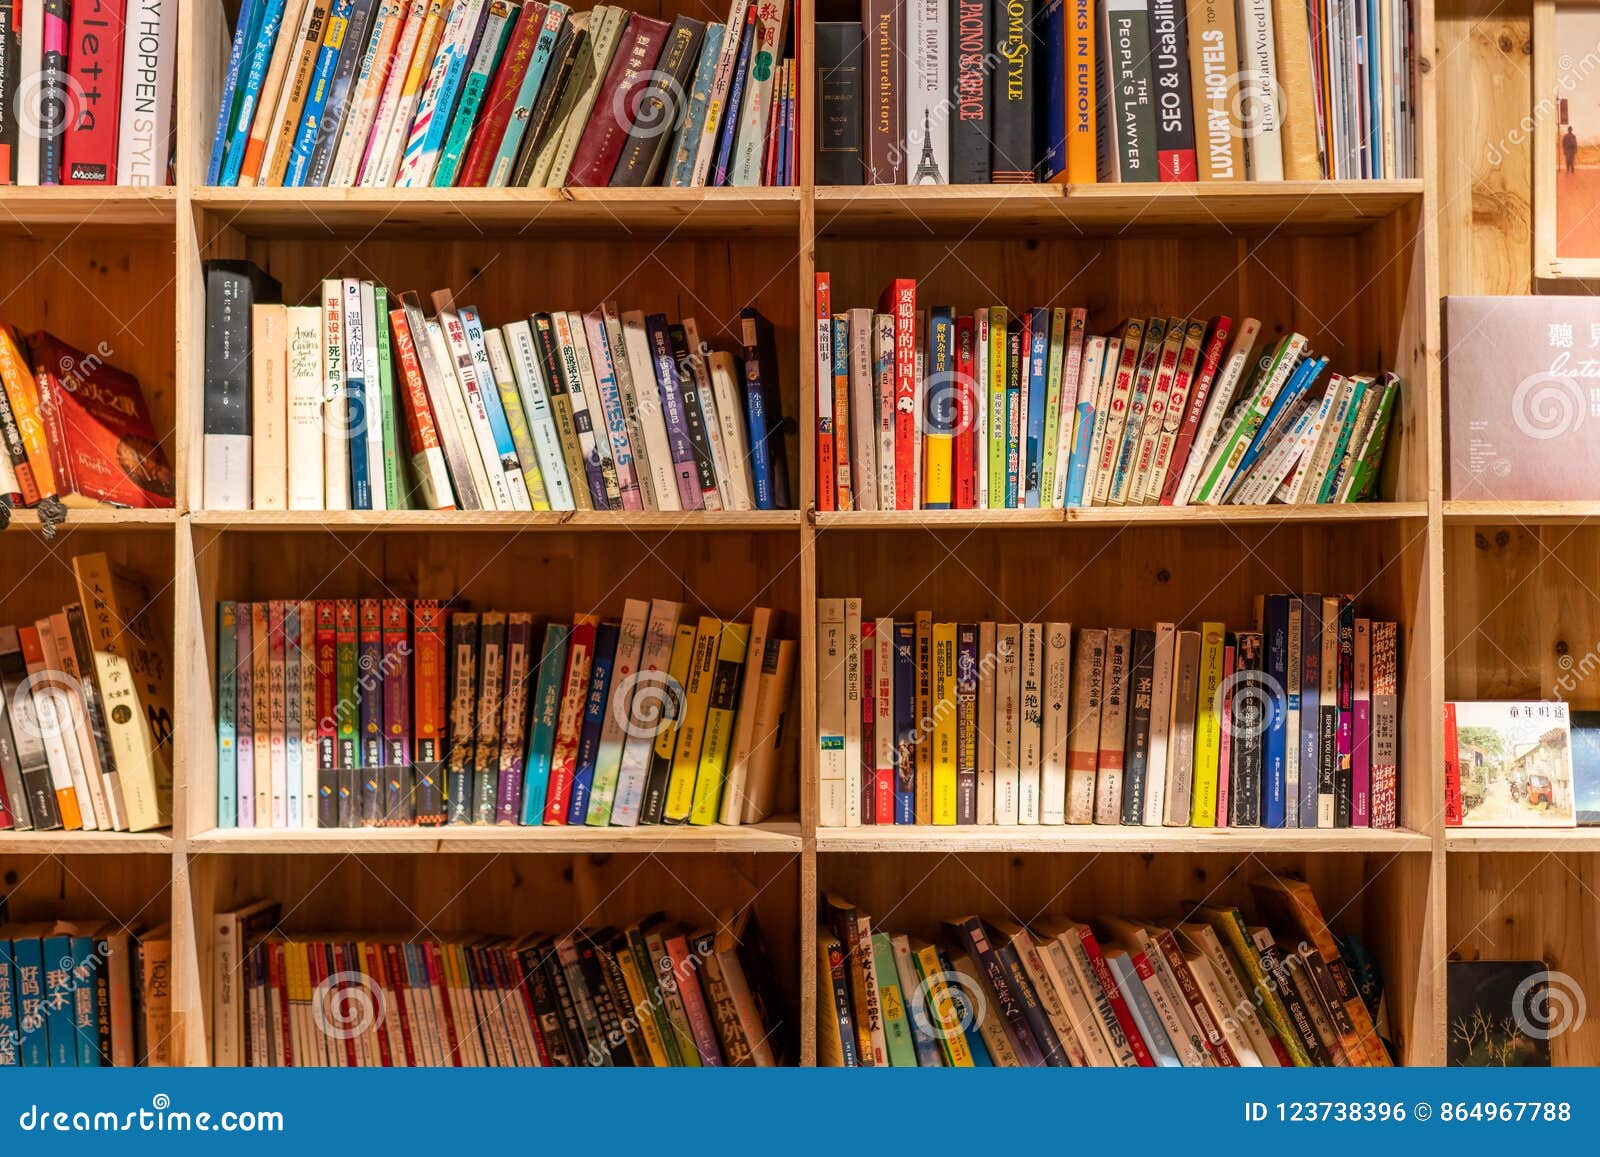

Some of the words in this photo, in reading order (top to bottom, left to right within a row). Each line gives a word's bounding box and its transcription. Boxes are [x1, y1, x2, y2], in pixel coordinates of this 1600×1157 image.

[959, 2, 984, 51] PACINO
[1074, 37, 1088, 57] IN
[1208, 7, 1216, 24] TOP
[135, 21, 161, 113] HOPPEN
[877, 14, 892, 135] Furniturehistory
[926, 29, 938, 92] ROMANTIC
[1001, 0, 1029, 101] OMESTYLE
[1118, 19, 1135, 96] PEOPLE'S
[1160, 72, 1179, 89] &
[1202, 30, 1228, 99] HOTELS
[959, 53, 984, 121] SCARFACE
[1077, 63, 1089, 134] EUROPE
[1137, 78, 1148, 105] THE
[1161, 97, 1182, 132] SEO
[130, 118, 153, 187] STYLE
[1123, 101, 1140, 170] LAWYER
[1206, 107, 1233, 178] LUXURY
[347, 311, 363, 373] 温柔的夜
[818, 322, 830, 362] 城南旧事
[898, 288, 915, 394] 耍聪明的中国人
[936, 323, 947, 372] 解忧杂货店
[462, 370, 482, 404] 三重门
[47, 969, 70, 1011] 我不
